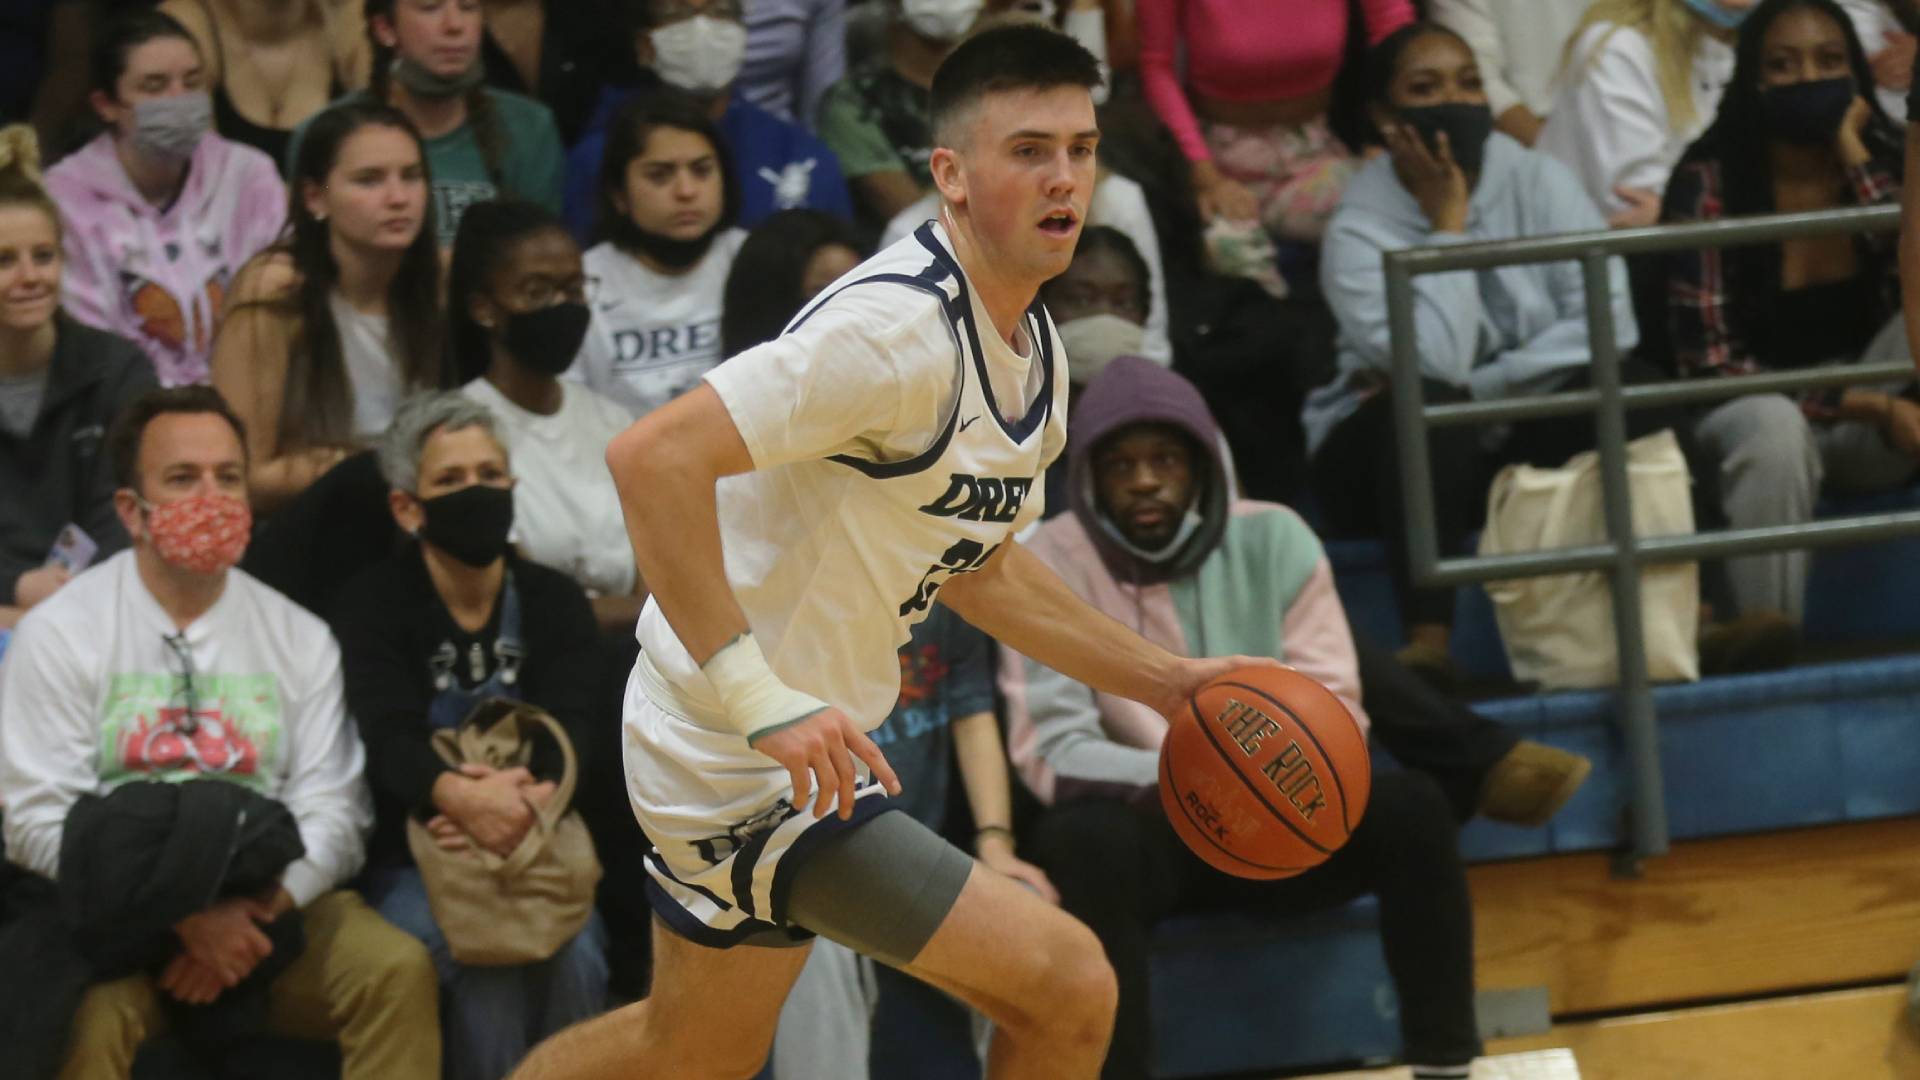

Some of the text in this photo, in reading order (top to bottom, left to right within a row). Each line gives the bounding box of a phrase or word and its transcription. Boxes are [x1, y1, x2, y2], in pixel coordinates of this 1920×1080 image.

[612, 319, 722, 362] DRE
[1216, 698, 1326, 823] THE ROCK
[1185, 789, 1229, 841] ROCK
